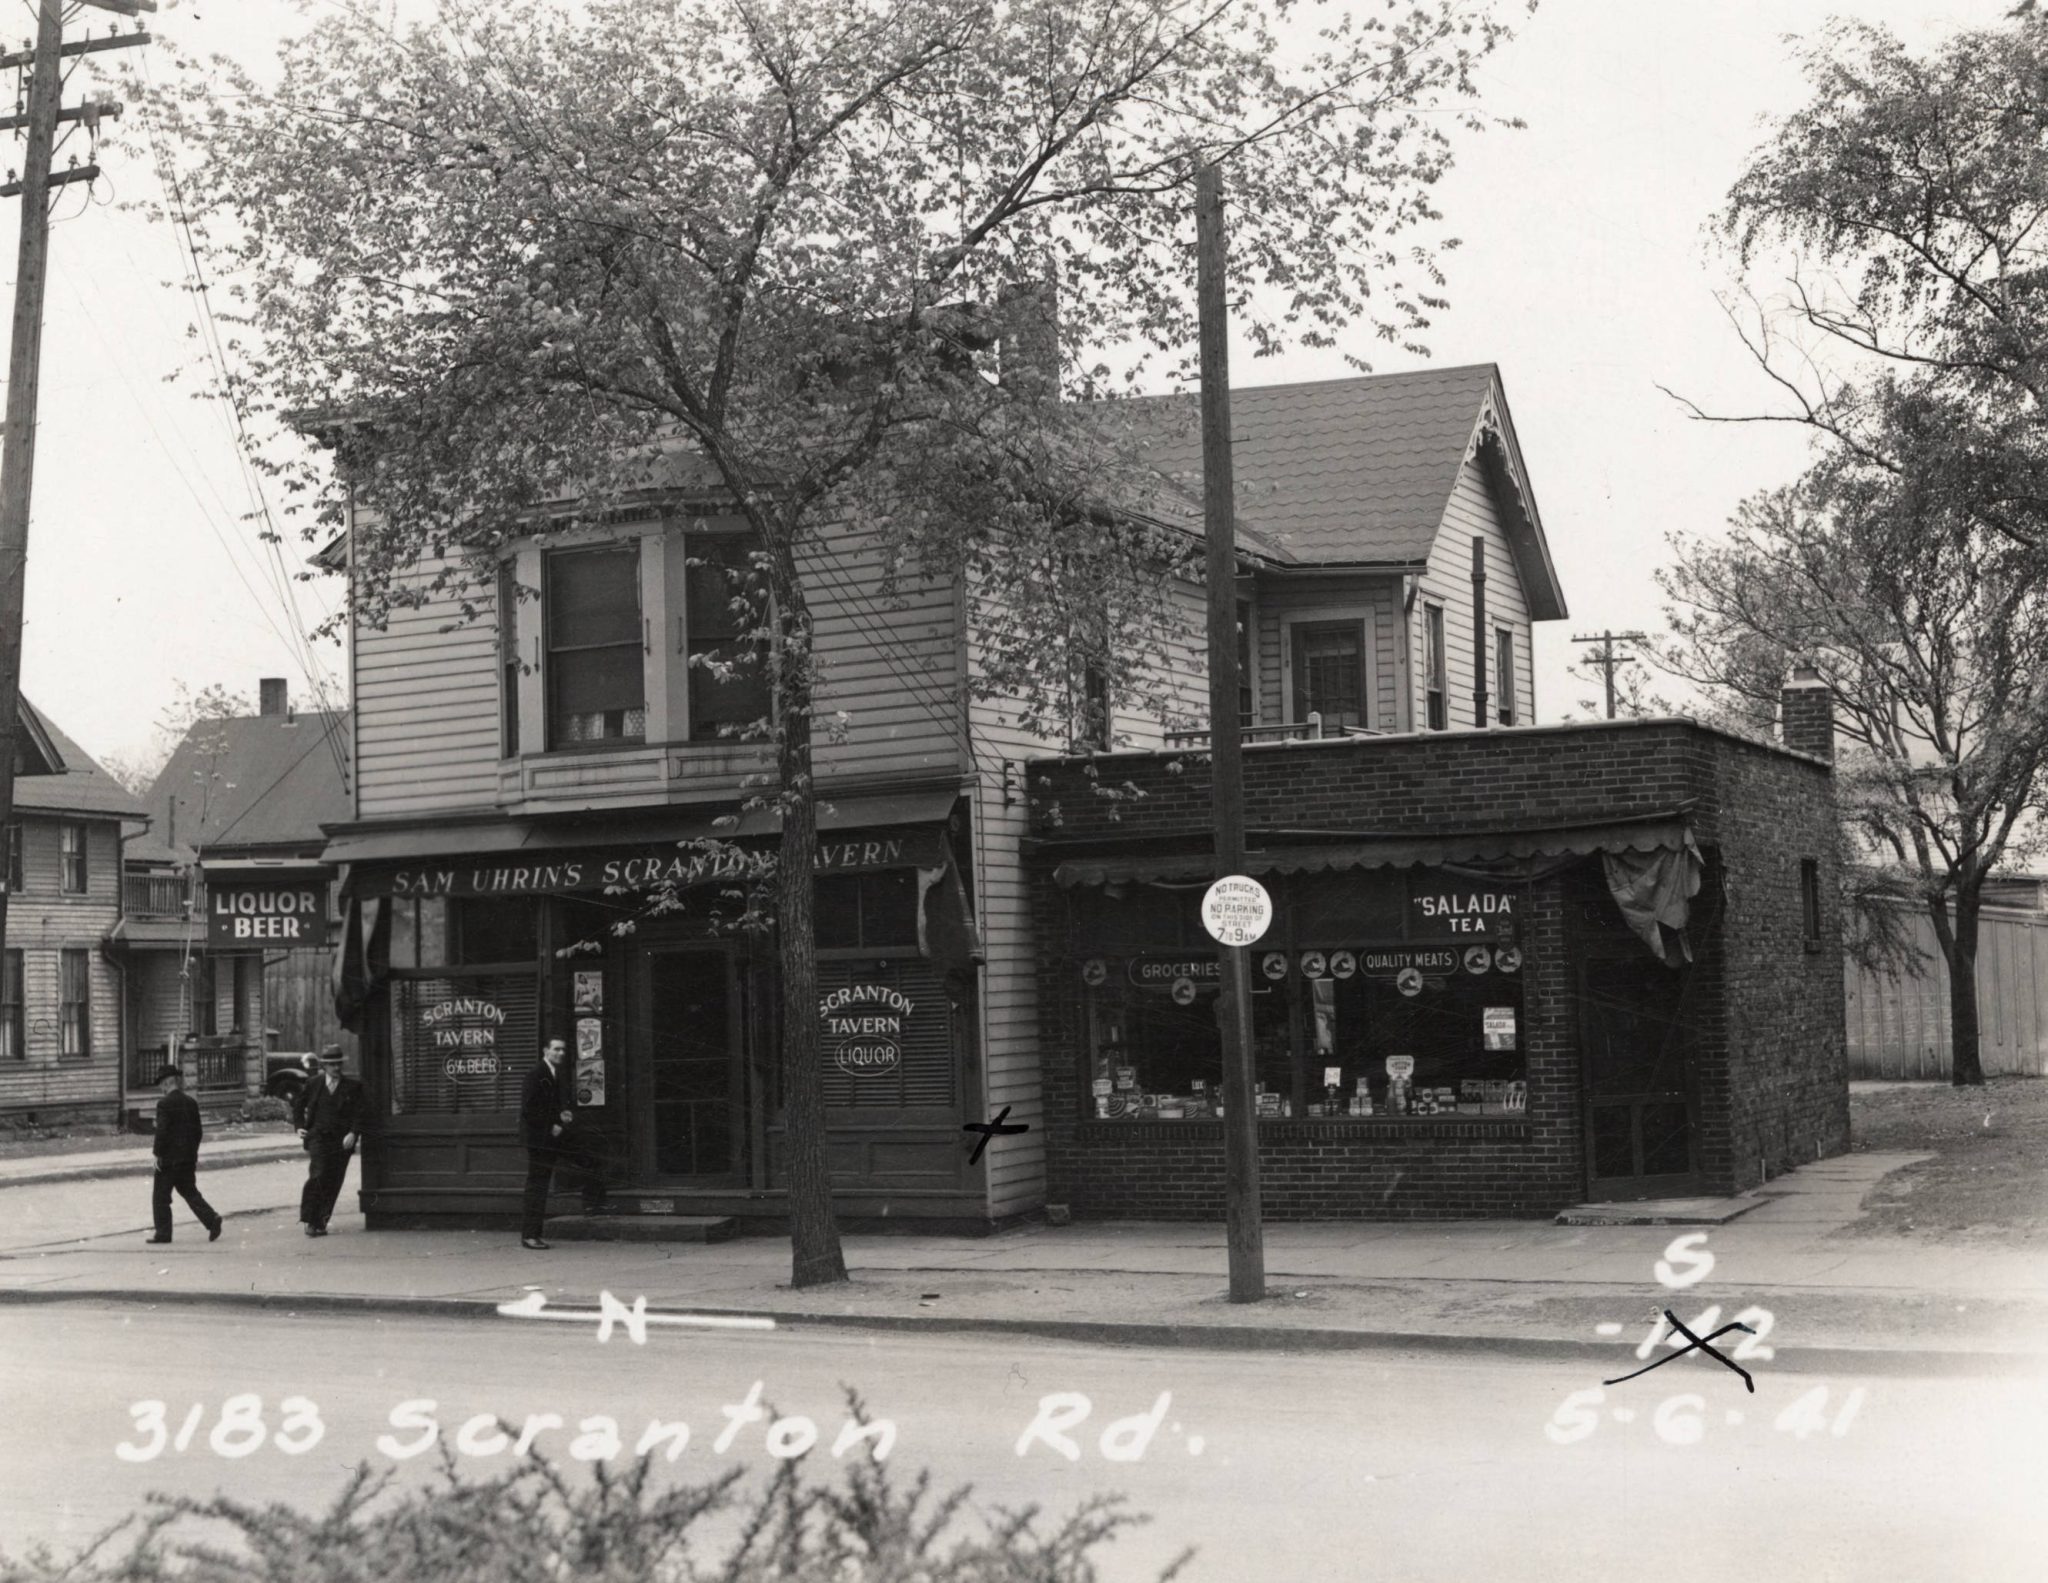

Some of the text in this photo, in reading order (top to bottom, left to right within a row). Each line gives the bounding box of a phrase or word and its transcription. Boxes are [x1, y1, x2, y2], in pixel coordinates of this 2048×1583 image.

[392, 871, 455, 893] SAM
[472, 862, 582, 892] UHRIN'S
[813, 839, 904, 870] VERN
[1215, 883, 1260, 898] NO TRUCKS
[216, 892, 316, 915] LIQUOR
[1210, 904, 1264, 914] NO PARKING
[1413, 894, 1517, 917] "SALADA"
[234, 917, 300, 938] BEER
[1449, 918, 1486, 932] TEA
[1216, 927, 1226, 941] 7
[1234, 928, 1244, 942] 9
[1366, 953, 1453, 969] QUALITY MEATS
[1142, 962, 1221, 978] GROCERIES
[819, 985, 915, 1017] SCRANTON
[422, 998, 507, 1026] SCRANTON
[828, 1017, 900, 1034] TAVERN
[433, 1030, 495, 1046] TAVERN
[840, 1046, 895, 1066] LIQUOR
[466, 1058, 497, 1074] BEER
